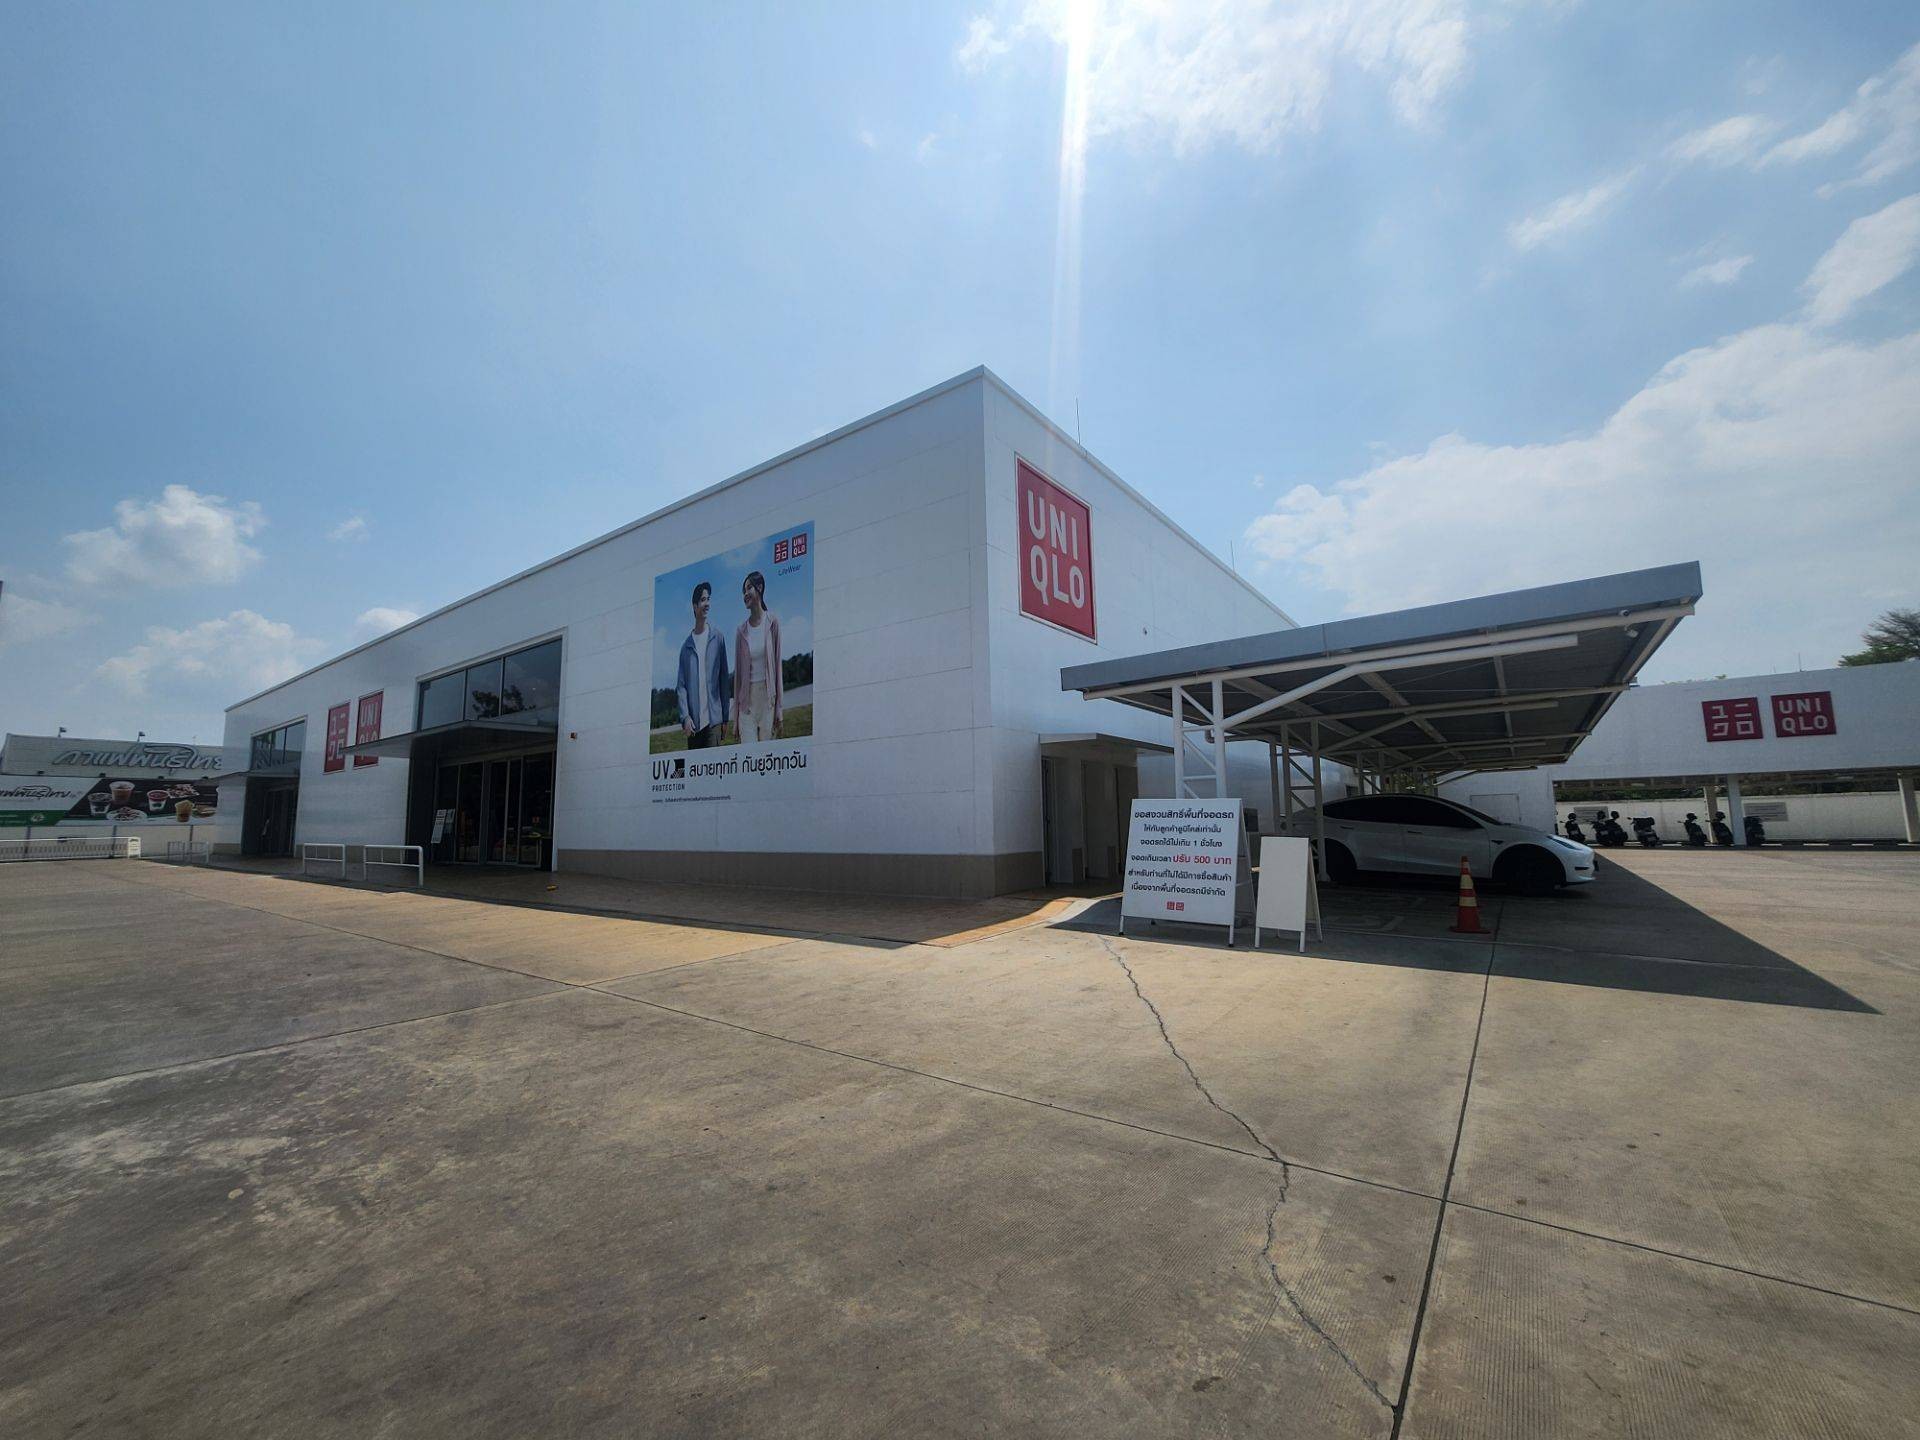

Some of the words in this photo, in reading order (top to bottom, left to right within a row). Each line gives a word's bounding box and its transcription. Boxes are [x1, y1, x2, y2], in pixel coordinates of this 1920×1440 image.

[1027, 488, 1079, 561] UNI
[1030, 544, 1085, 609] QLO
[360, 704, 378, 727] UNI
[1779, 697, 1822, 714] UNI
[1782, 715, 1829, 734] QLO
[652, 760, 671, 780] UV
[689, 753, 738, 780] สบายทุกที่
[742, 750, 808, 777] กันยูวีทุกวัน
[651, 782, 686, 793] PROTECTION
[1172, 853, 1191, 863] ปรับ
[1194, 855, 1211, 864] 500
[1213, 857, 1232, 865] บาท
